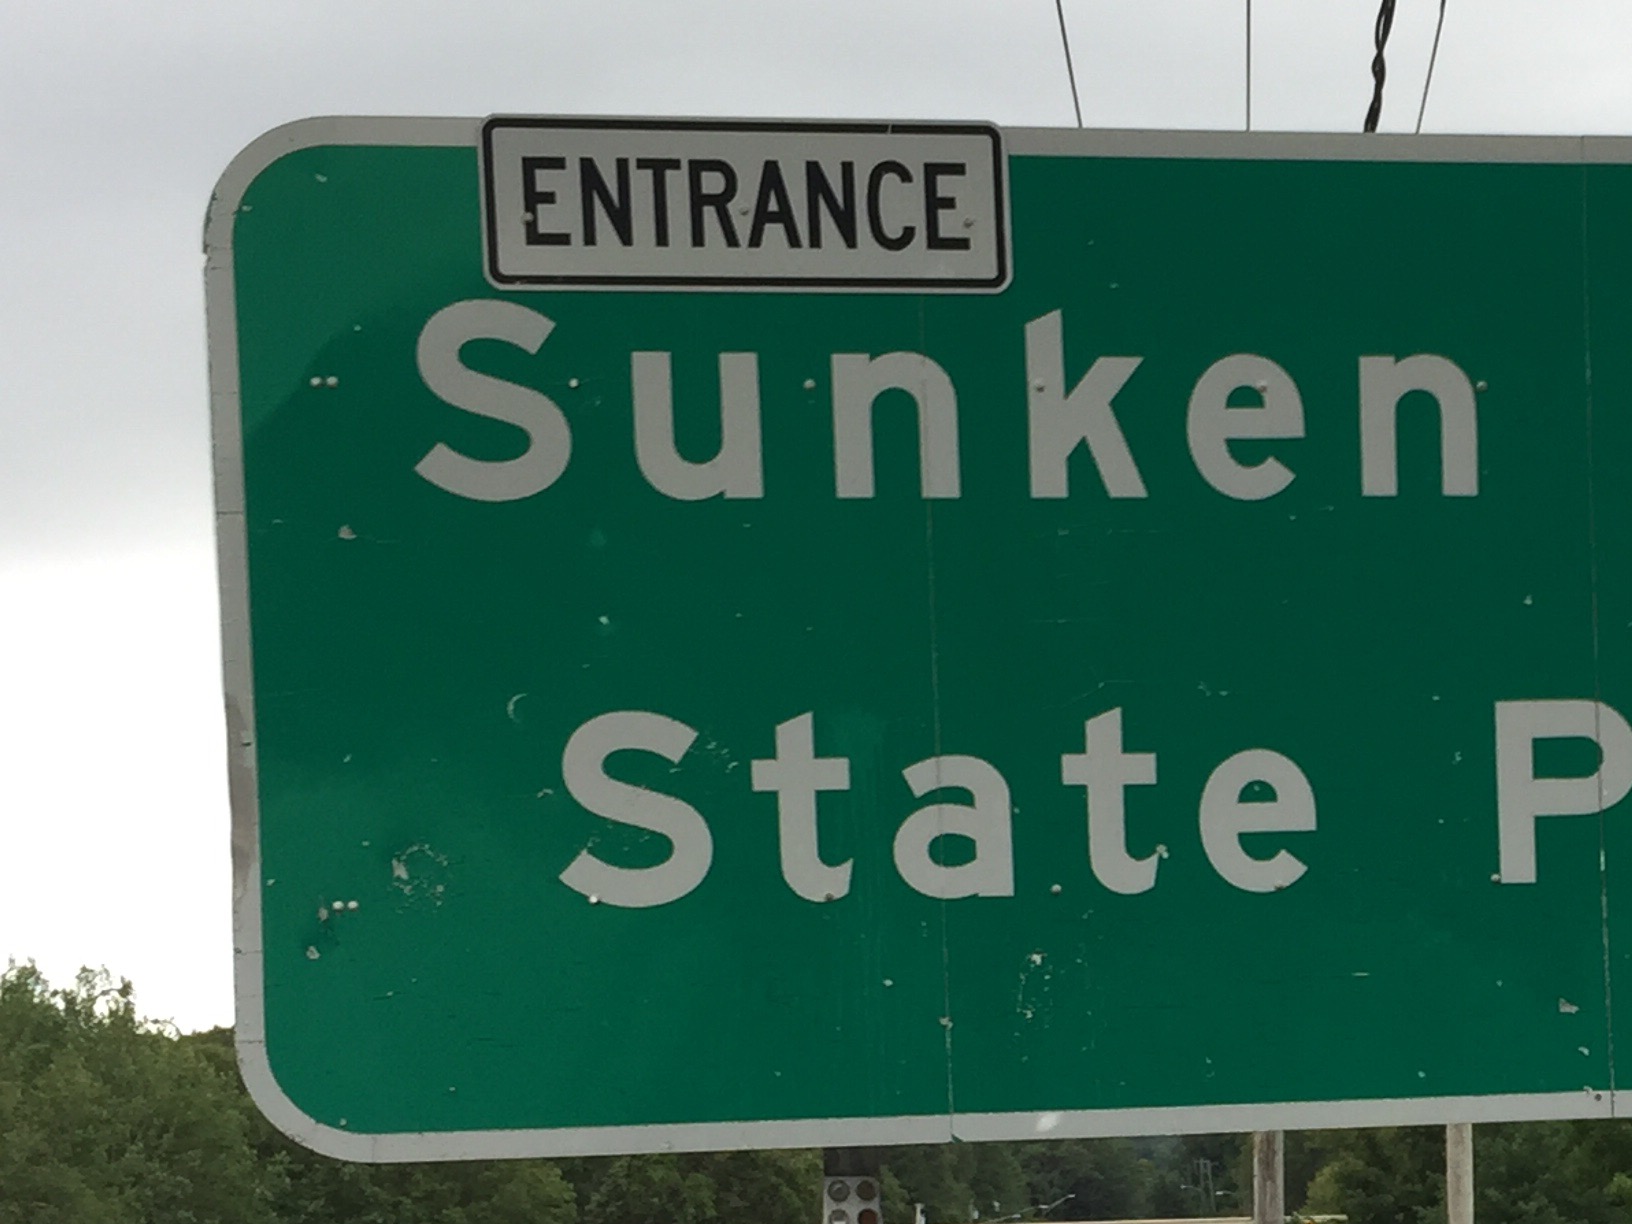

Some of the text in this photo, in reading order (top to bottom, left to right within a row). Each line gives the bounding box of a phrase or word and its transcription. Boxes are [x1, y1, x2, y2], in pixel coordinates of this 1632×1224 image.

[521, 155, 971, 252] ENTRANCE
[414, 298, 1479, 502] Sunken
[557, 706, 1318, 909] State
